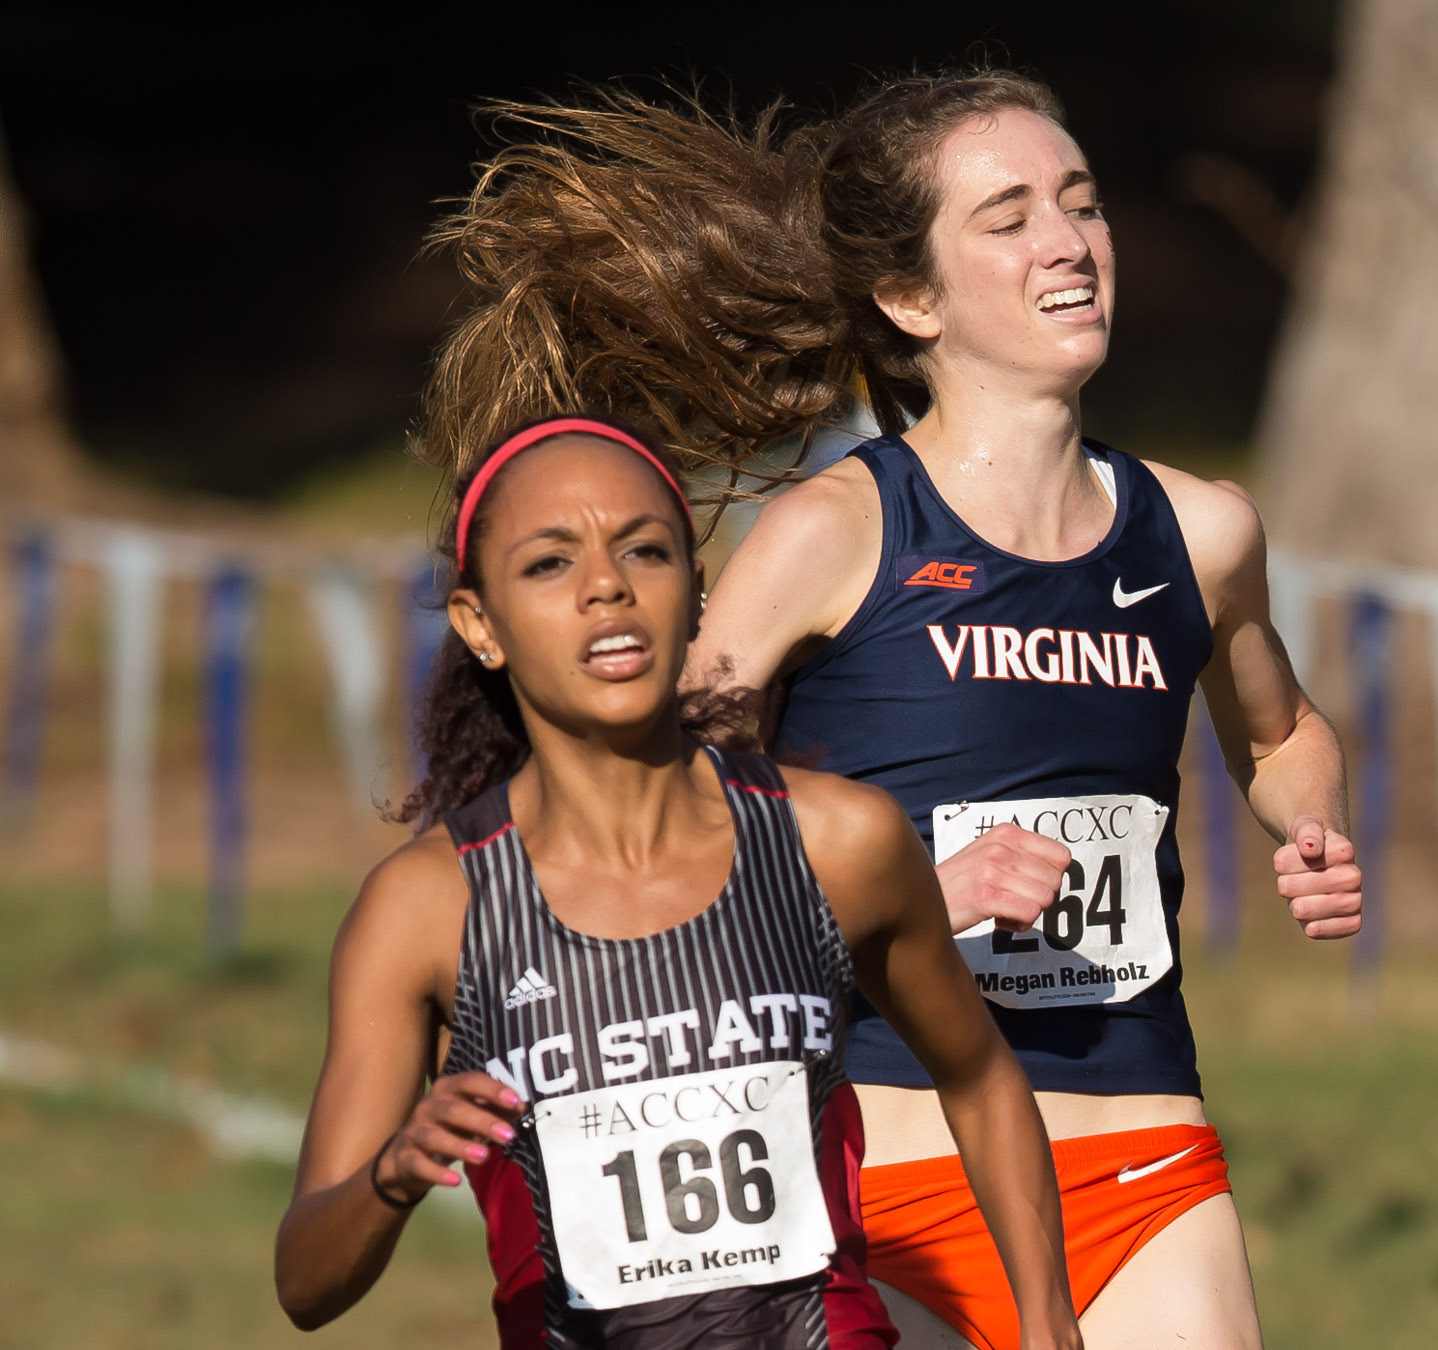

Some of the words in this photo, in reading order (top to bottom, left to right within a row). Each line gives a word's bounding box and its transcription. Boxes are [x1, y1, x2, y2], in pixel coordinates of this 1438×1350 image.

[904, 561, 978, 589] ACC
[926, 624, 1169, 691] VIRGINIA
[504, 985, 557, 1010] adidas
[975, 971, 1055, 994] Megan
[1060, 961, 1150, 987] Rebholz
[485, 1032, 579, 1103] NC
[598, 993, 832, 1081] STATE
[579, 1075, 771, 1139] #ACCXC
[602, 1128, 776, 1243] 166
[617, 1257, 693, 1285] Erika
[702, 1244, 781, 1271] Kemp
